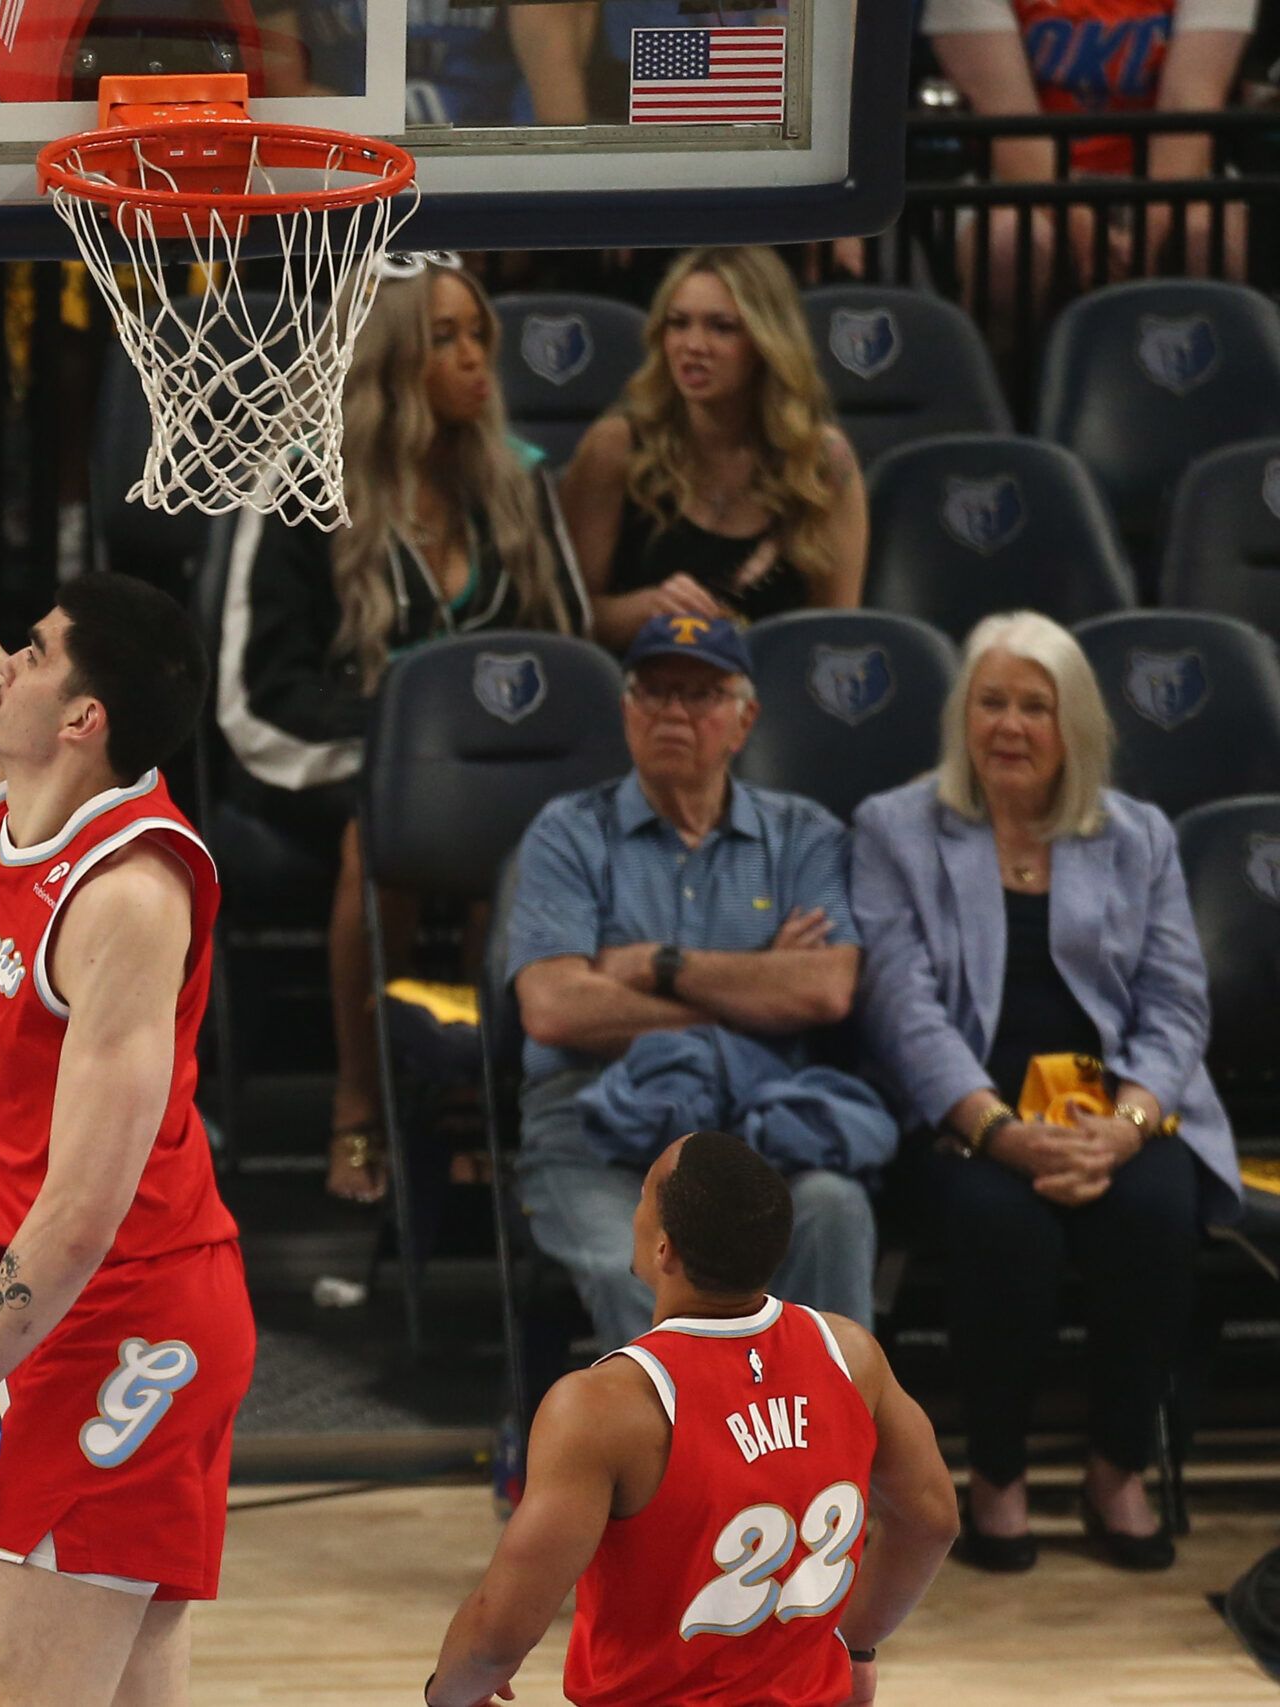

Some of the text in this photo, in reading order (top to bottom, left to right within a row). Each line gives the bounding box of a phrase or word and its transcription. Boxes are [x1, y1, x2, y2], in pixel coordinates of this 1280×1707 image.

[669, 615, 711, 646] T
[725, 1395, 809, 1464] BANE
[679, 1480, 865, 1642] 22
